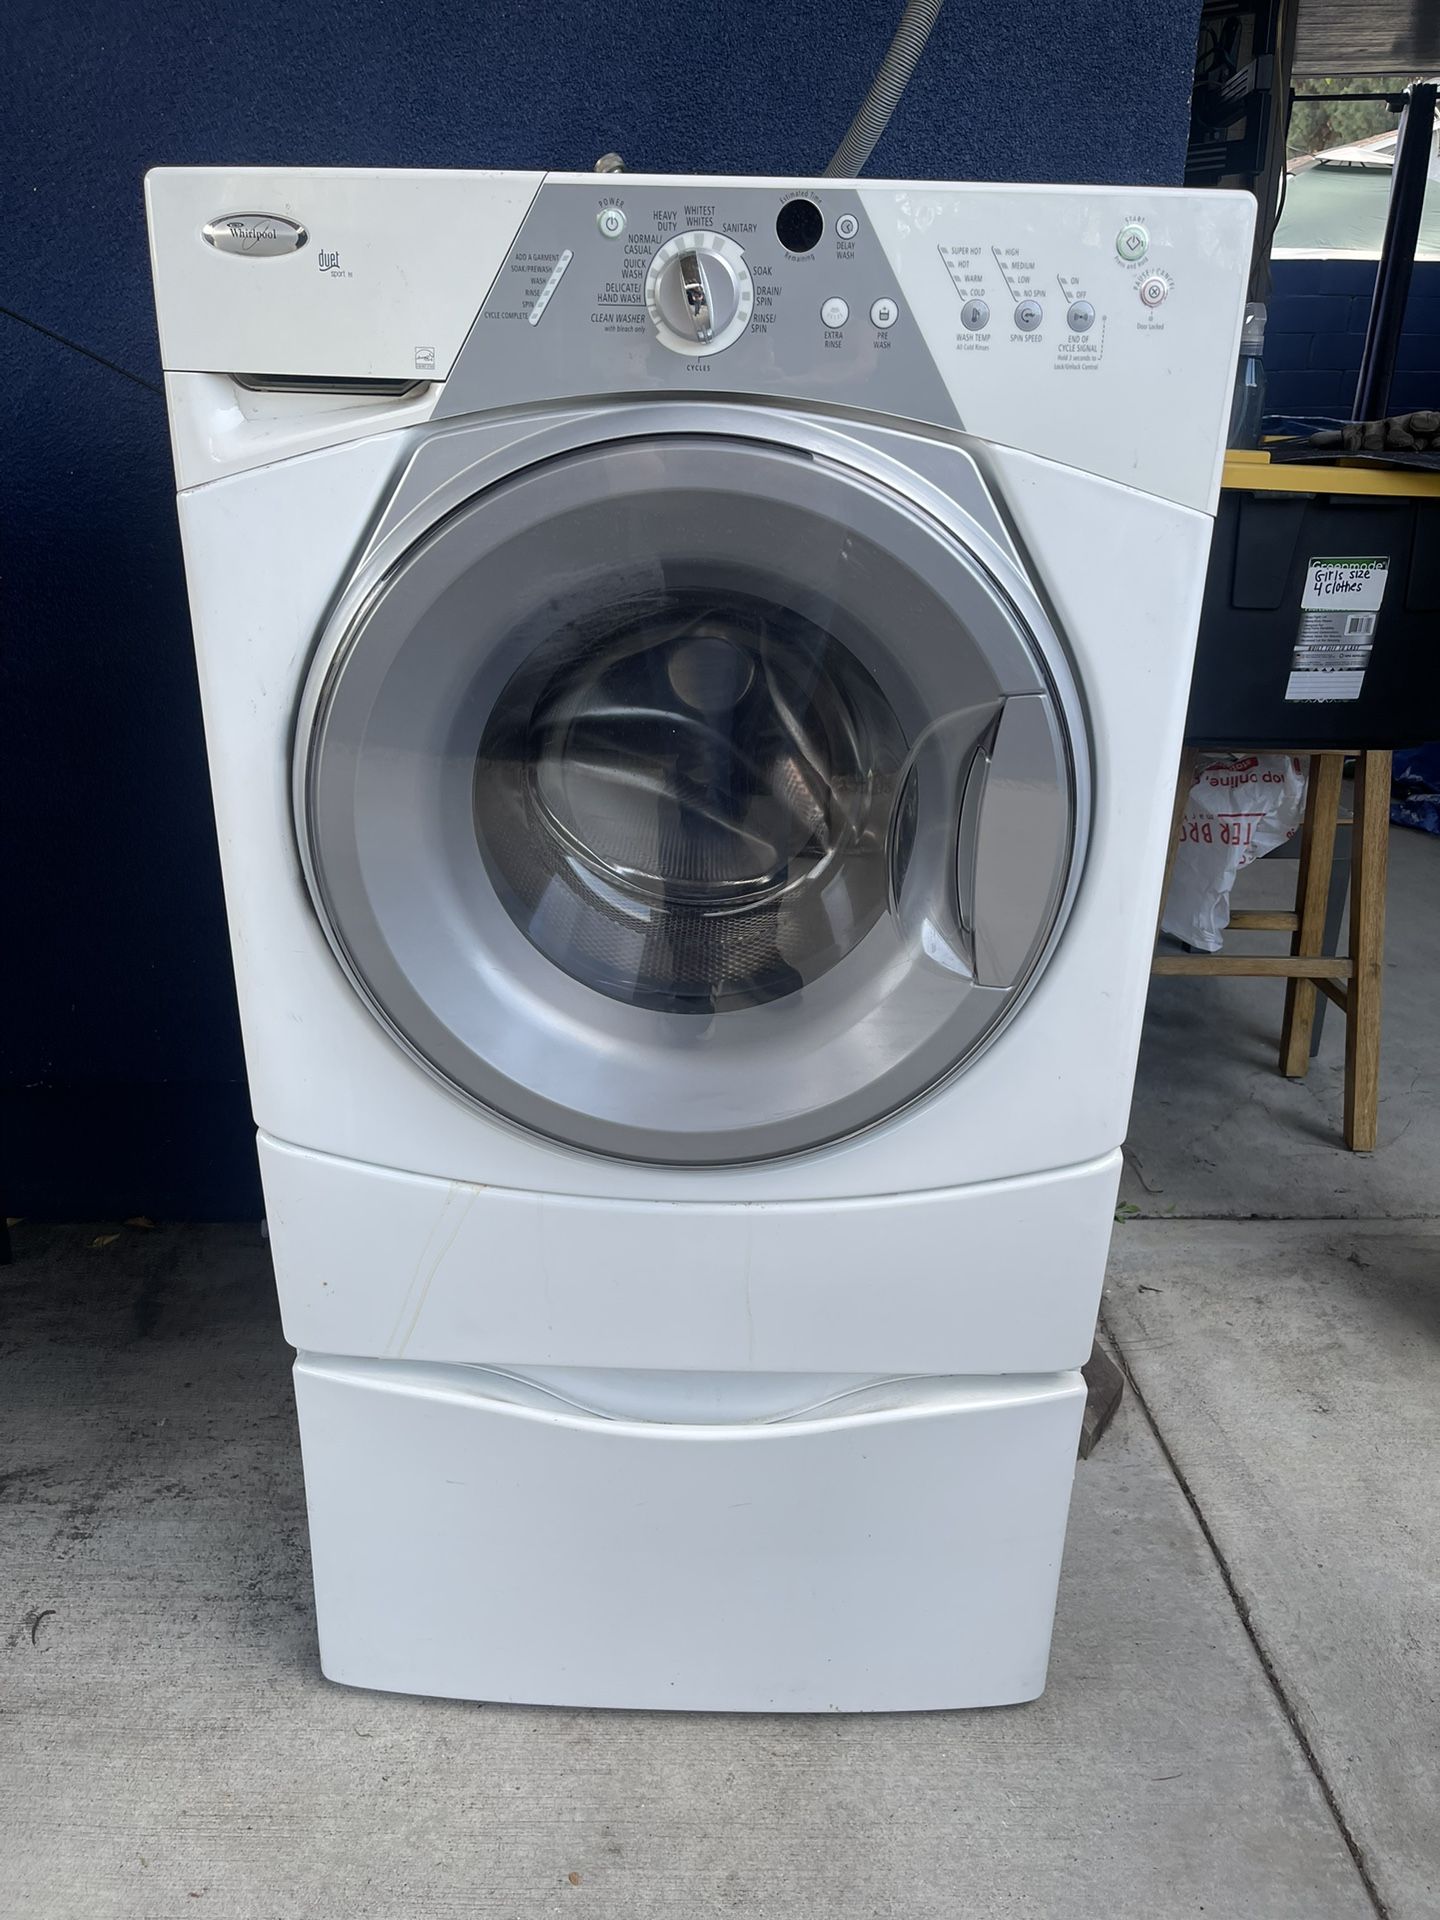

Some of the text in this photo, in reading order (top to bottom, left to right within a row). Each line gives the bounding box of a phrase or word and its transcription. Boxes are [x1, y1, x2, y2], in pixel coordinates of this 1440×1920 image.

[598, 197, 625, 208] POWER
[683, 205, 715, 216] WHITEST
[653, 210, 677, 221] HEAVY
[1125, 215, 1145, 223] START
[686, 216, 713, 227] WHITES
[657, 221, 677, 232] DUTY
[722, 222, 758, 233] SANITARY
[228, 228, 277, 241] Whirlpool
[628, 234, 663, 245] NORMAL/
[624, 244, 652, 255] CASUAL
[836, 241, 855, 250] DELAY
[951, 246, 982, 255] SUPER HOT
[1005, 248, 1020, 256] HIGH
[318, 249, 339, 267] duet
[515, 253, 527, 261] ADD
[532, 254, 560, 262] GARMENT
[836, 251, 855, 260] WASH
[623, 259, 647, 269] QUICK
[957, 260, 970, 268] HOT
[1011, 262, 1035, 270] MEDIUM
[330, 270, 346, 278] sport
[621, 269, 643, 279] WASH
[752, 265, 773, 276] SOAK
[530, 277, 547, 285] WASH
[964, 275, 983, 283] WARM
[1017, 276, 1030, 284] LOW
[1070, 277, 1080, 285] ON
[605, 282, 641, 293] DELICATE/
[756, 286, 782, 297] DRAIN/
[525, 289, 541, 297] RINSE
[970, 289, 986, 297] COLD
[1023, 290, 1047, 298] NO SPIN
[1076, 291, 1087, 299] OFF
[597, 293, 641, 303] HAND WASH
[756, 296, 773, 307] SPIN
[522, 300, 535, 308] SPIN
[484, 311, 529, 320] CYCLE COMPLETE
[590, 313, 646, 324] CLEAN WASHER
[753, 313, 777, 324] RINSE/
[634, 326, 646, 334] only
[751, 324, 768, 334] SPIN
[1136, 322, 1148, 331] Door
[824, 331, 843, 340] EXTRA
[877, 332, 889, 341] PRE
[956, 333, 991, 342] WASH TEMP
[1010, 333, 1043, 343] SPIN SPEED
[1068, 335, 1090, 344] END OF
[824, 340, 842, 349] RINSE
[873, 341, 892, 350] WASH
[1057, 344, 1098, 353] CYCLE SIGNAL
[686, 364, 711, 372] CYCLES
[1314, 569, 1371, 582] Girls size
[1313, 582, 1323, 597] 4
